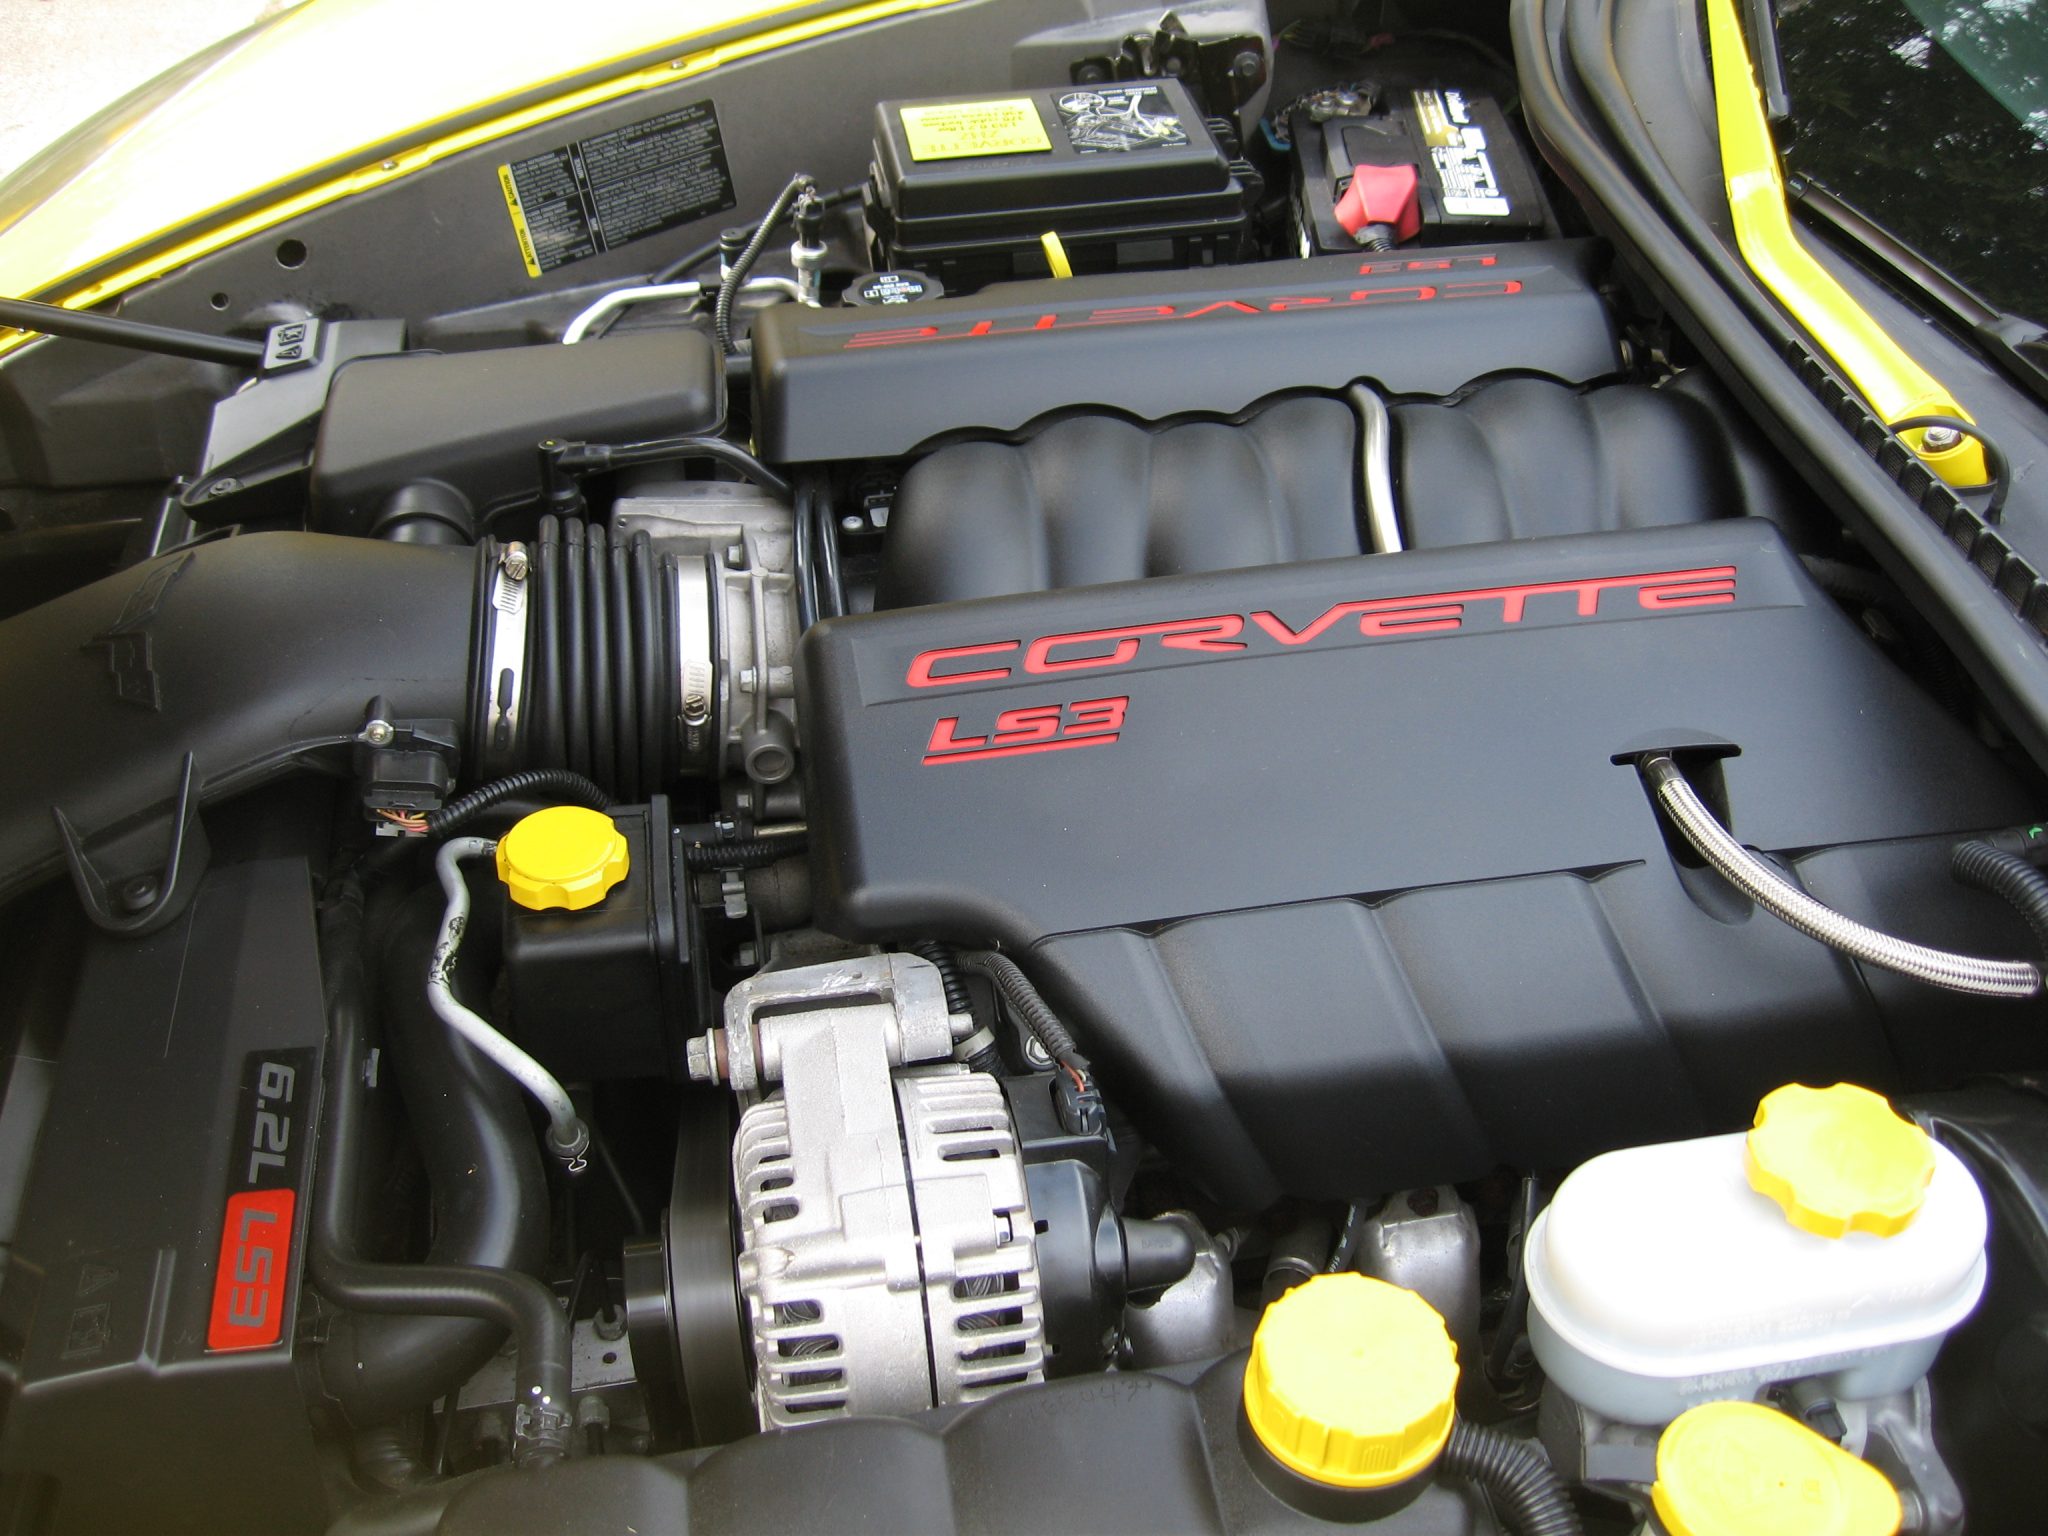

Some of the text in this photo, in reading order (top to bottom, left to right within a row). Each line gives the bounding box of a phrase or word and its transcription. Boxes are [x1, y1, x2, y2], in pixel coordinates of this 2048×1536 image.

[844, 280, 1522, 348] CORVETTE
[906, 566, 1736, 688] CORVETTE
[923, 695, 1128, 760] LS3
[249, 1062, 295, 1184] 6.2L
[229, 1208, 278, 1328] LS3
